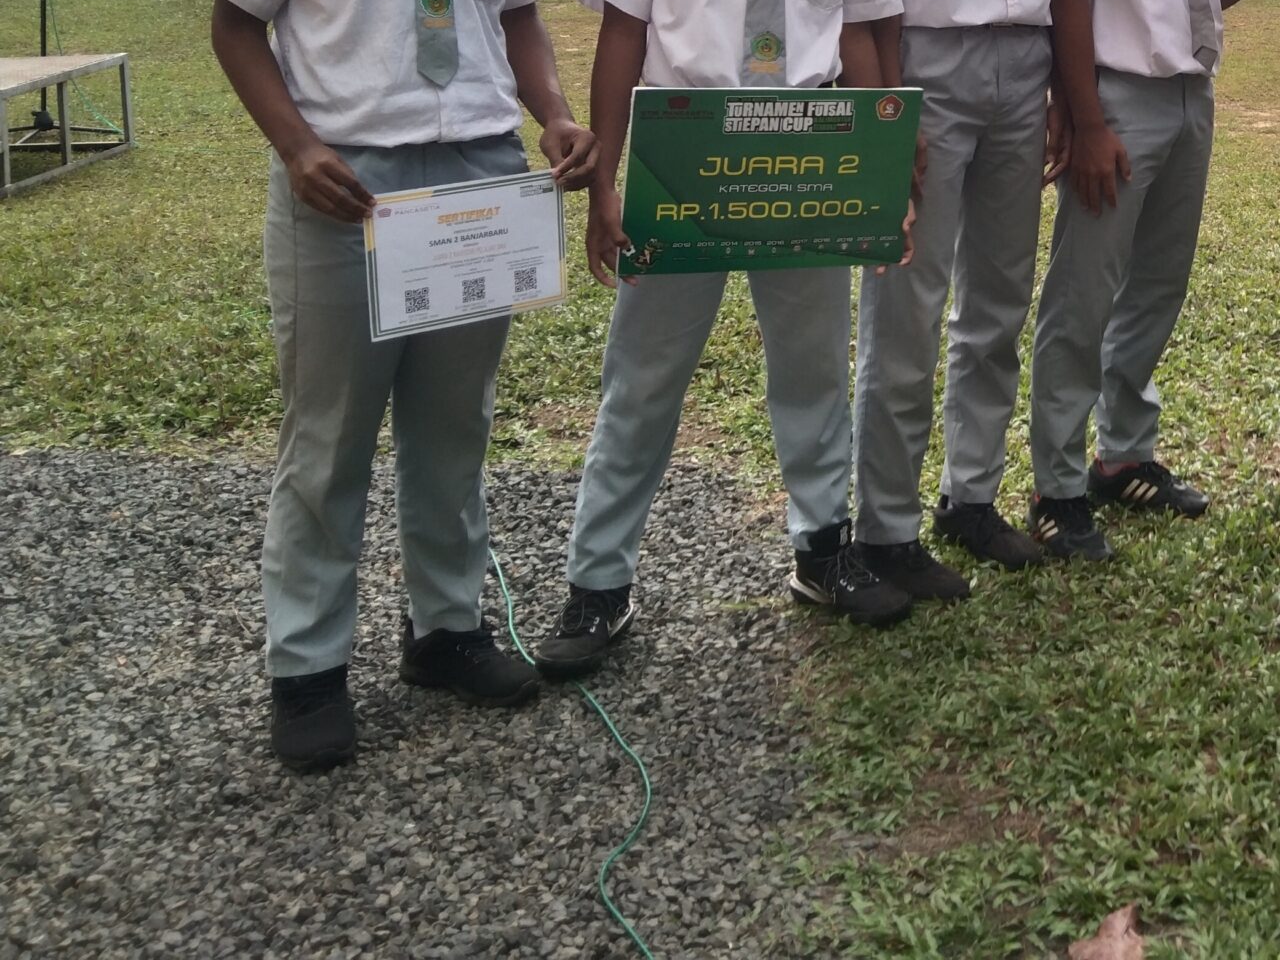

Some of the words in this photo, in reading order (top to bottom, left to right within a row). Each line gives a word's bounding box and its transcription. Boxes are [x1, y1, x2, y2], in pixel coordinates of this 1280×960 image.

[781, 116, 814, 133] CUP
[699, 155, 825, 176] JUARA
[838, 155, 860, 174] 2
[719, 183, 793, 193] KATEGORI
[797, 183, 833, 192] SMA
[437, 206, 501, 224] SERTIFIKAT
[428, 238, 453, 248] SMAN
[460, 227, 509, 242] BANJARBARU
